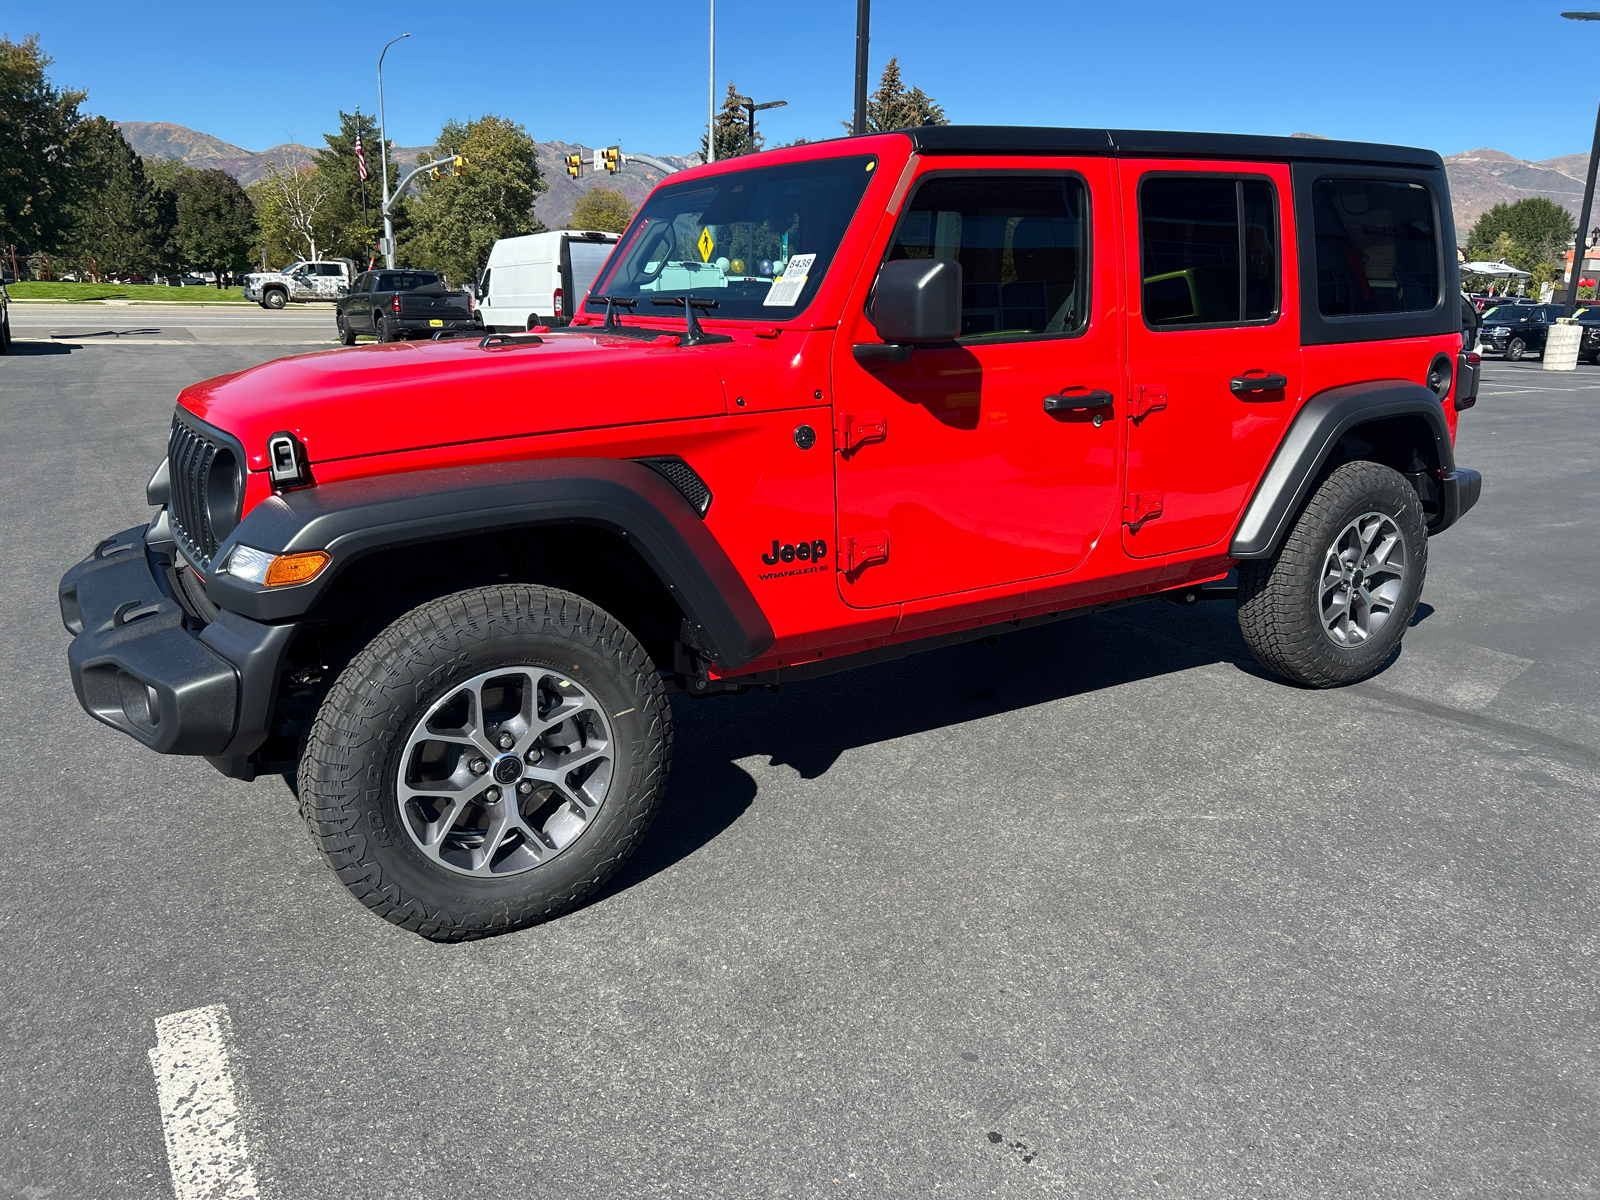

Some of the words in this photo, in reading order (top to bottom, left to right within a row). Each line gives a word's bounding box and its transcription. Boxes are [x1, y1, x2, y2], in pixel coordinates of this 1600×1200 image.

[789, 258, 812, 269] 8438
[762, 539, 827, 565] Jeep
[758, 567, 818, 580] WRANGLER
[365, 705, 408, 848] ROADIAN
[415, 652, 473, 703] ATX
[582, 739, 645, 865] NEXEN
